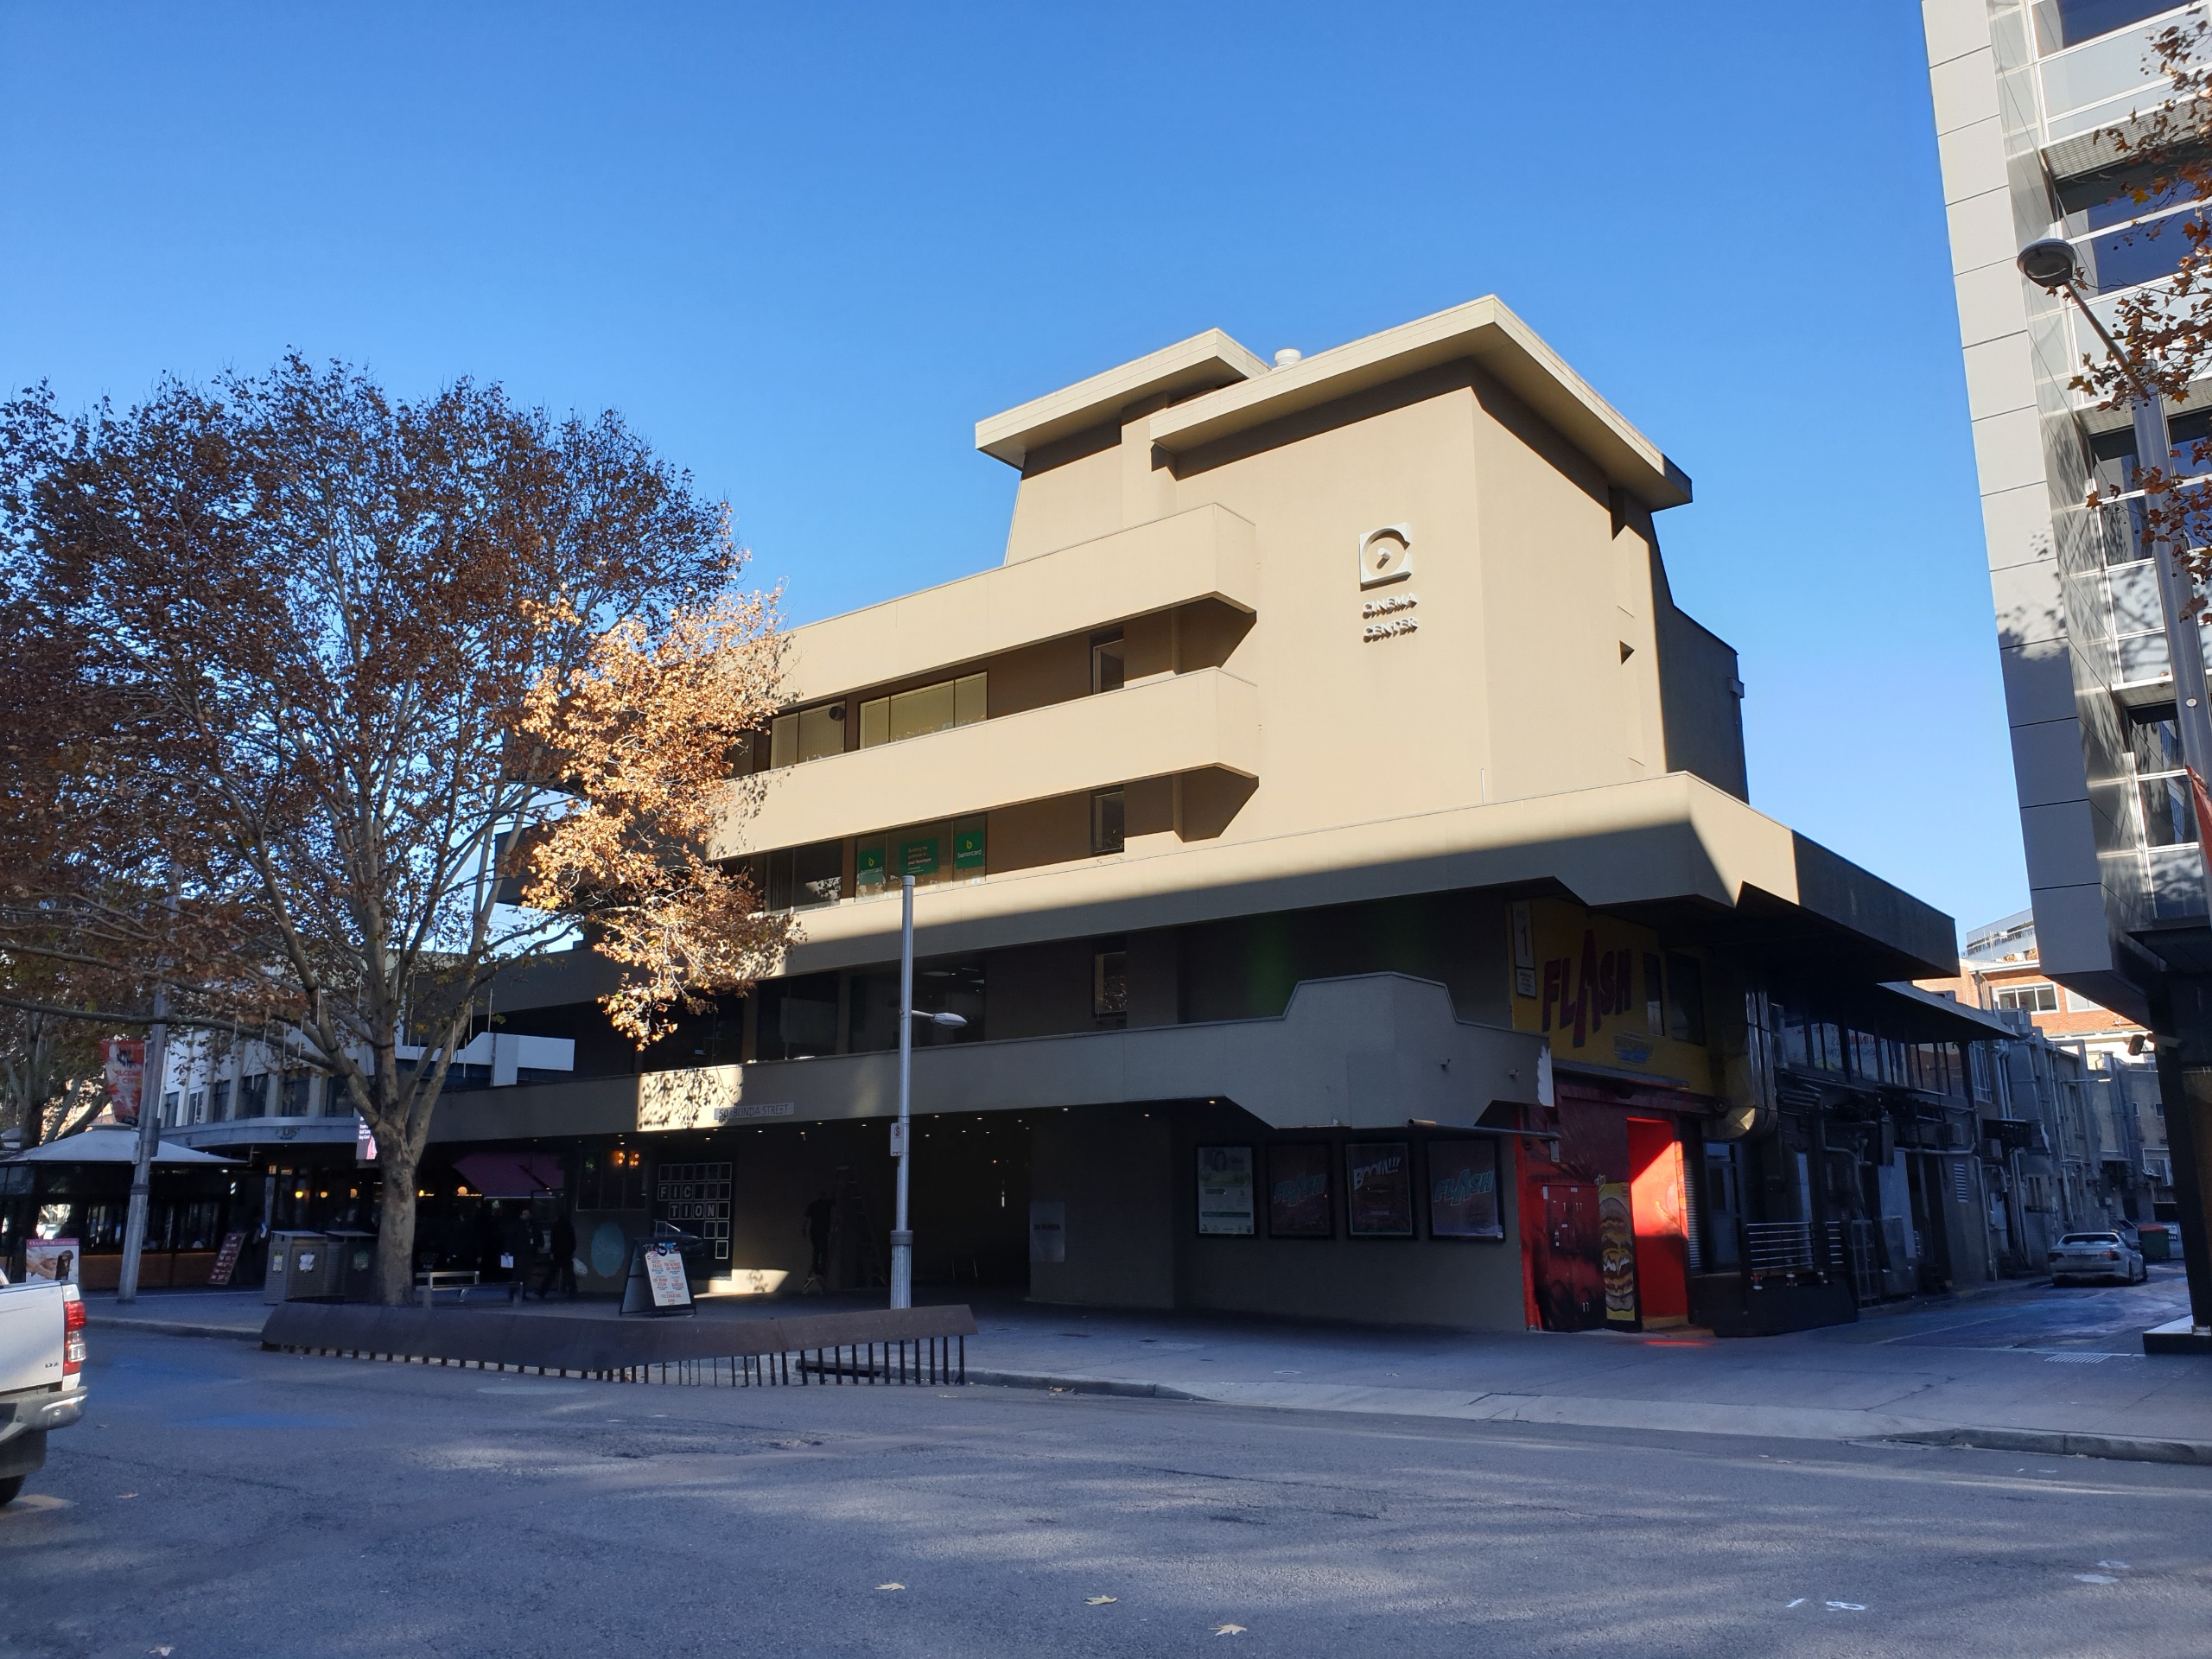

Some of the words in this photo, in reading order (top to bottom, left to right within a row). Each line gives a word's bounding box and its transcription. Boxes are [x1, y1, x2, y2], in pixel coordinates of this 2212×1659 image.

[1363, 592, 1417, 614] CINEMA
[1363, 616, 1419, 638] CENTER
[958, 849, 982, 858] bartercard
[1541, 929, 1632, 1047] FLASH
[719, 1109, 728, 1118] 50
[734, 1106, 760, 1117] BUNDA
[762, 1103, 789, 1116] STREET
[1353, 1157, 1402, 1191] BOOM!!!
[660, 1185, 691, 1198] FIC
[1274, 1172, 1326, 1207] FLASH
[1434, 1168, 1494, 1206] FLASH
[671, 1205, 715, 1217] TION
